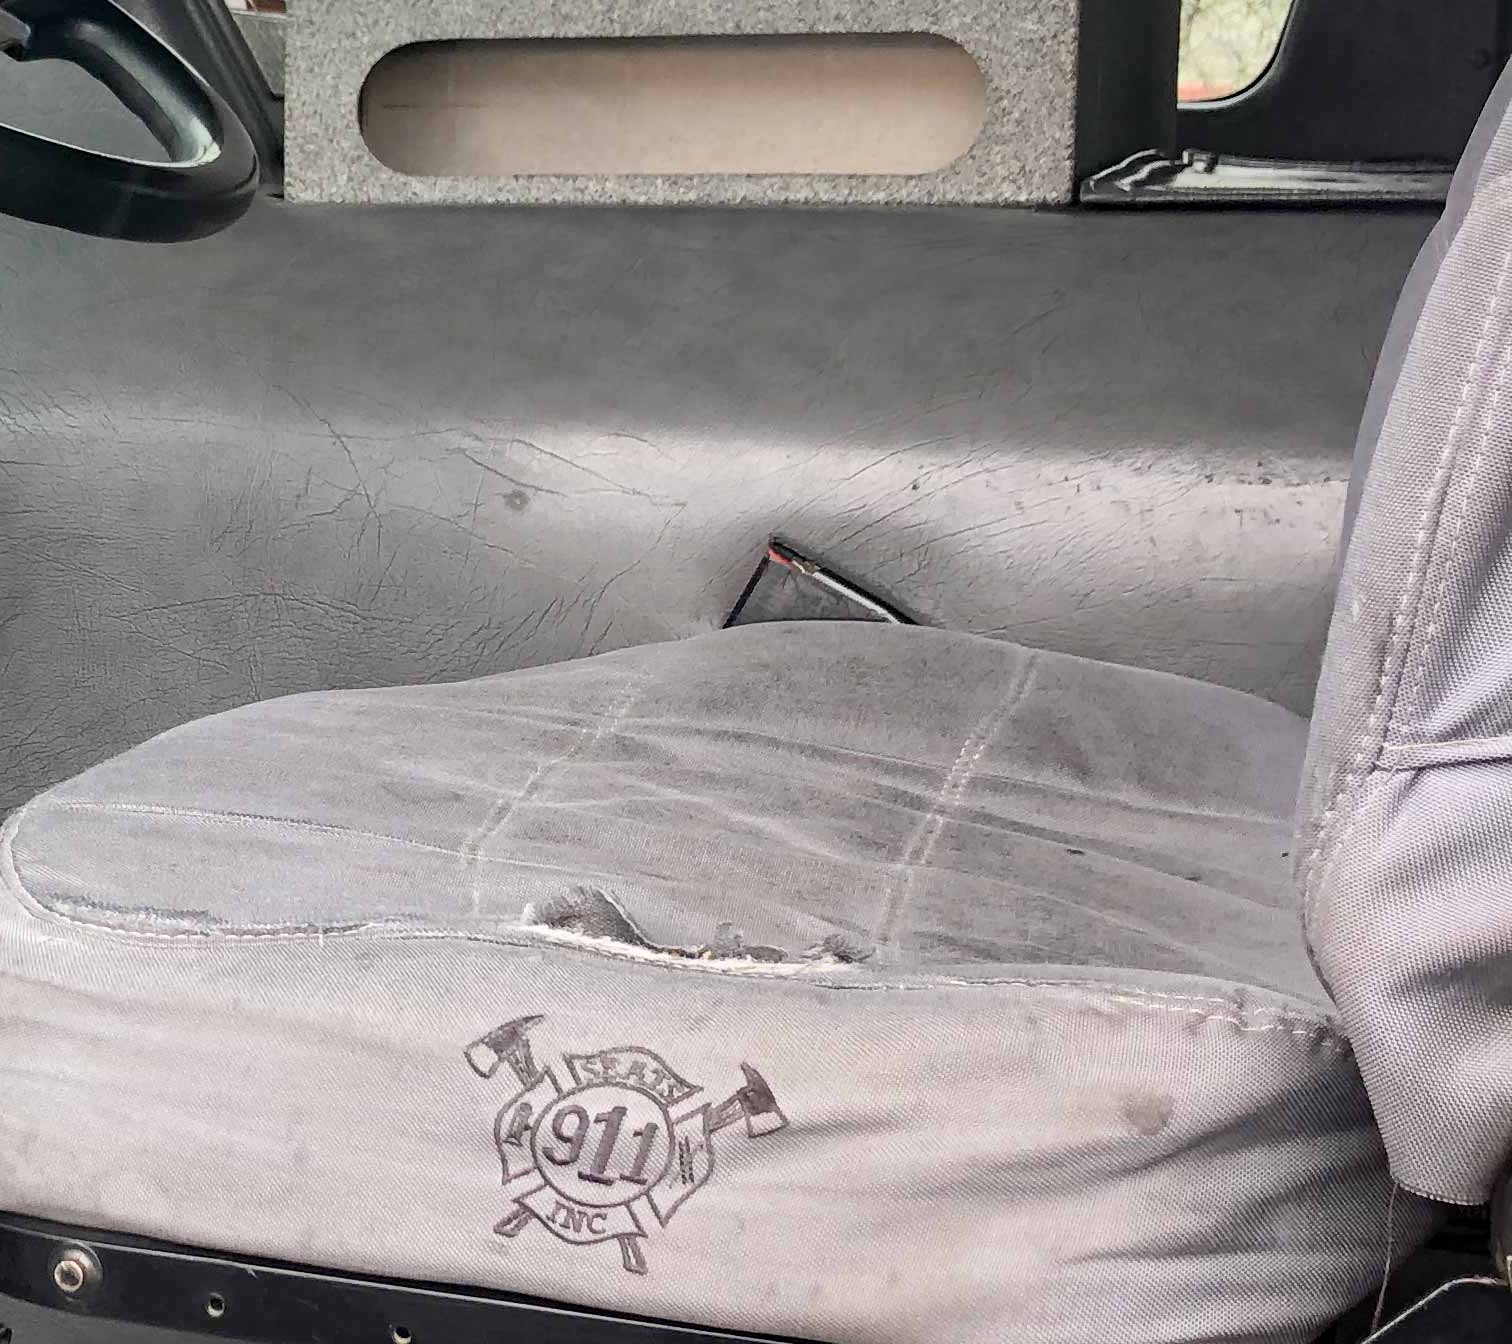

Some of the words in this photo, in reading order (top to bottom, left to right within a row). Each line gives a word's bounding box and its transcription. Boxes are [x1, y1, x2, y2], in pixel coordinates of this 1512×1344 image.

[579, 1057, 685, 1101] SEATS
[541, 1103, 659, 1187] 911
[545, 1199, 608, 1235] INC
